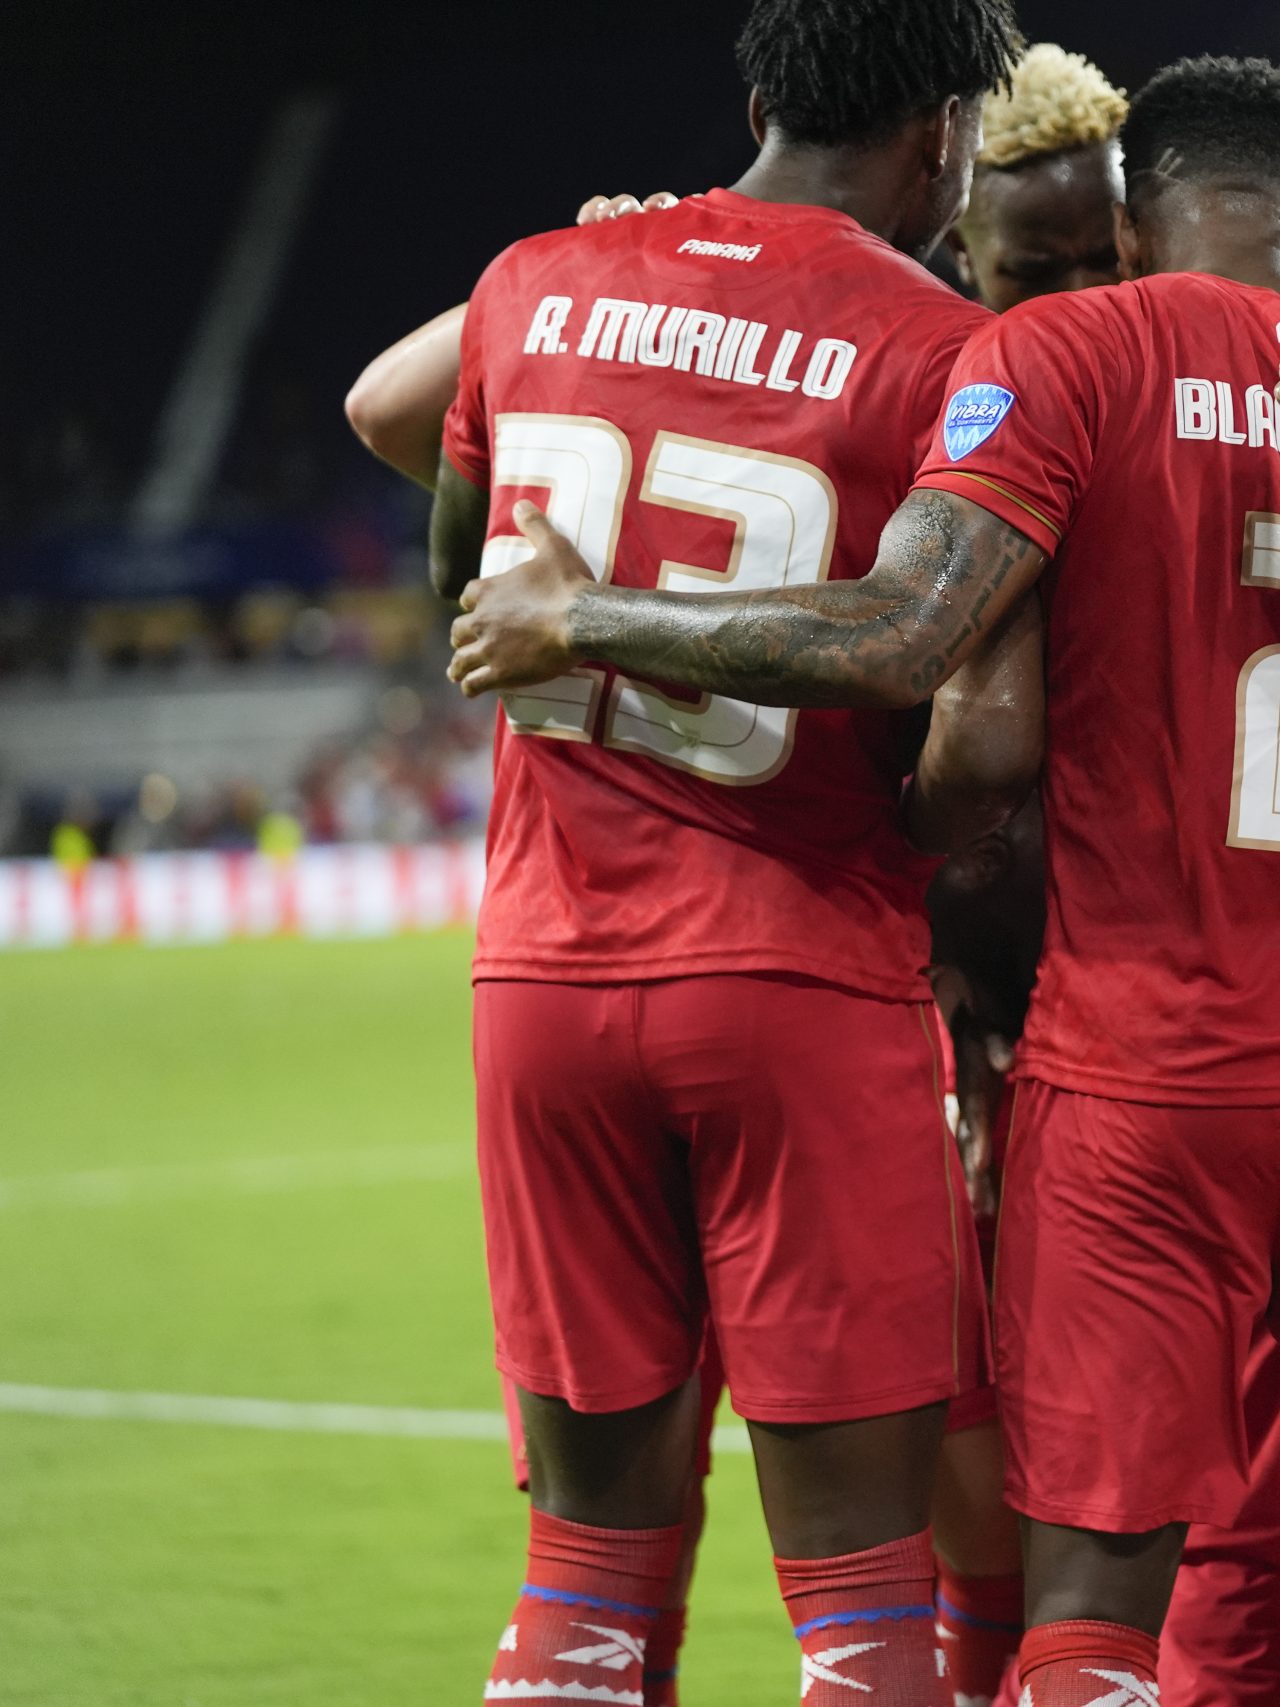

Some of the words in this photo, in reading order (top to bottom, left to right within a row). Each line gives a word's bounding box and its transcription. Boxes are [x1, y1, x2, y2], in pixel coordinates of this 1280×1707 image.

[677, 238, 763, 262] PANAMÁ
[523, 296, 573, 354] R.
[577, 297, 857, 400] MURILLO
[950, 404, 1002, 420] VIBRA
[479, 412, 839, 787] 23
